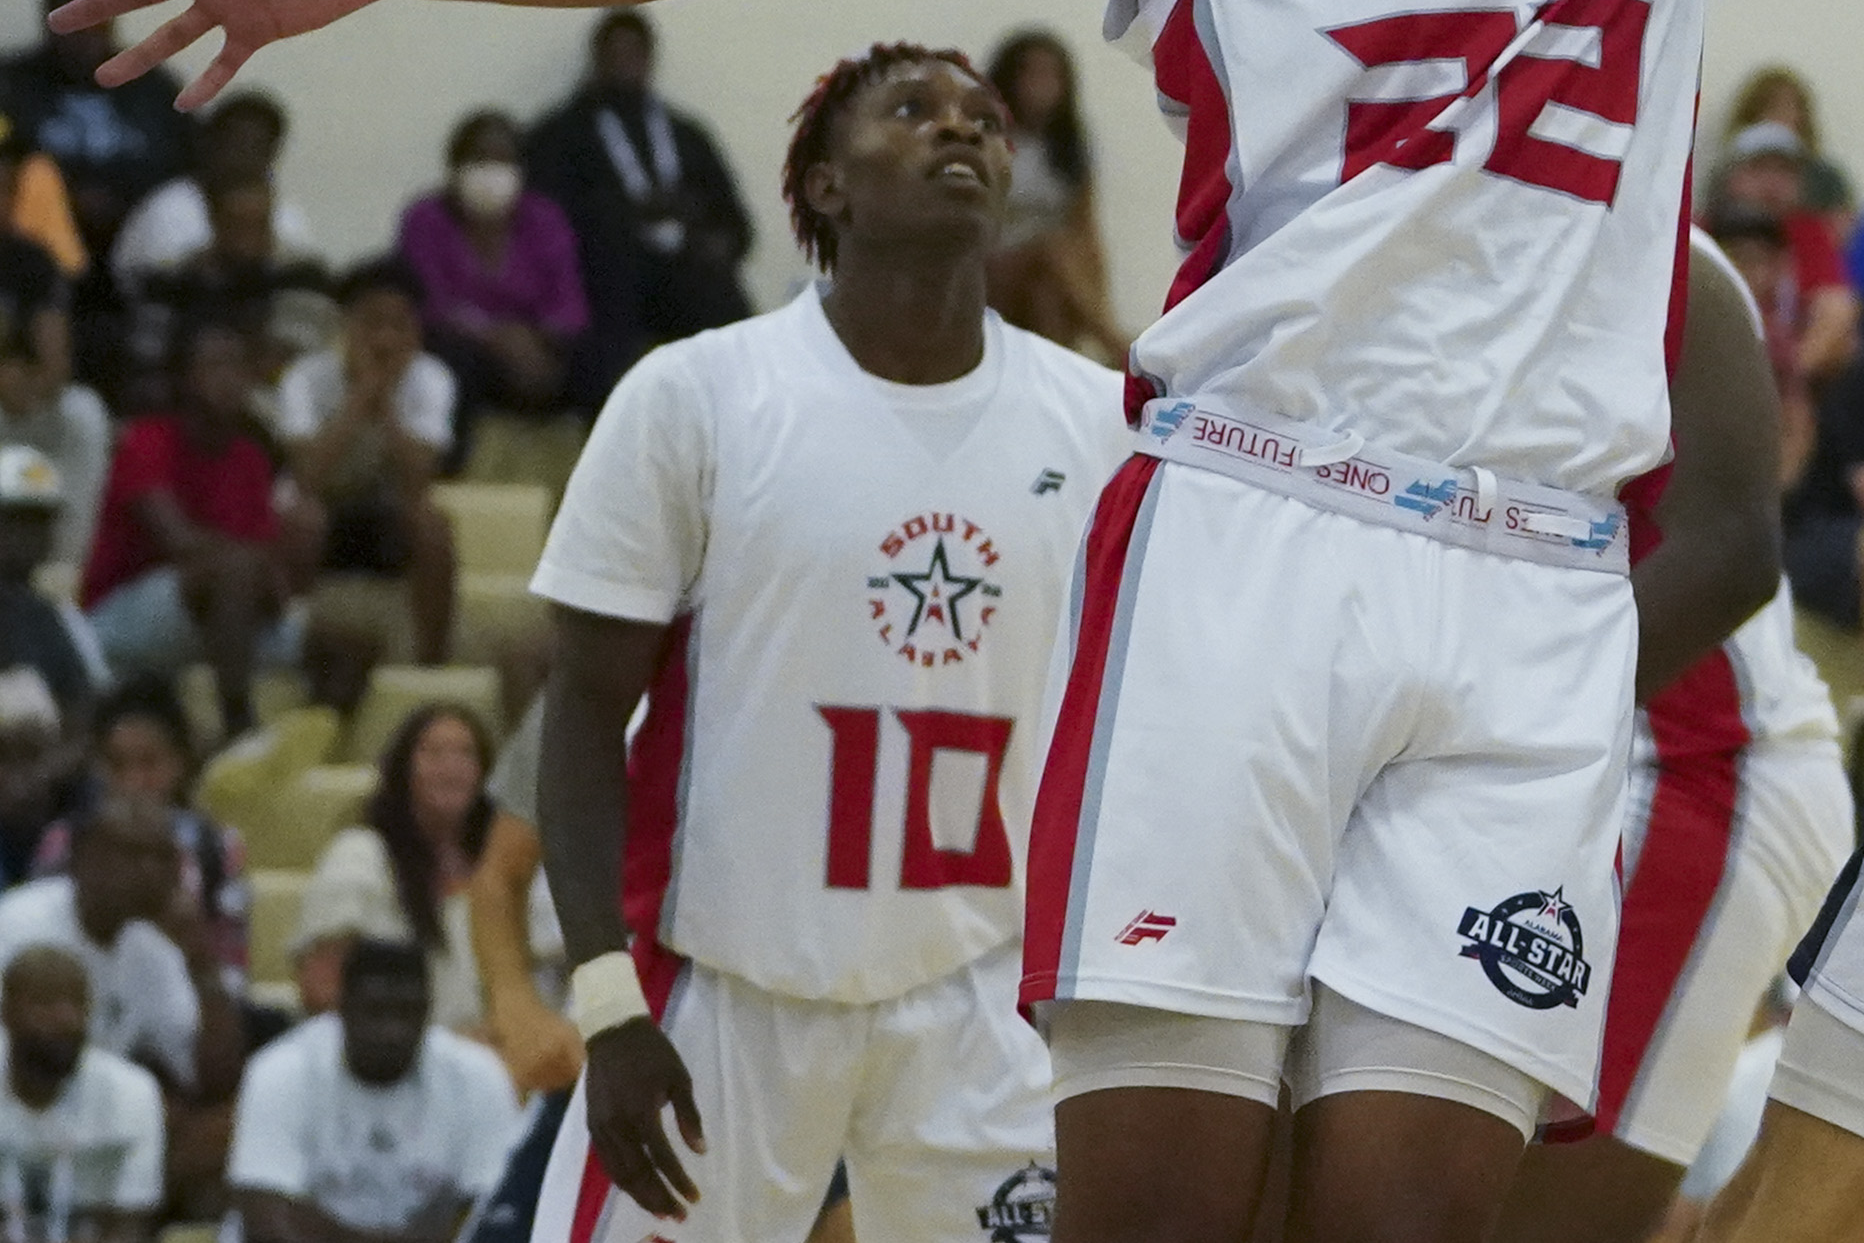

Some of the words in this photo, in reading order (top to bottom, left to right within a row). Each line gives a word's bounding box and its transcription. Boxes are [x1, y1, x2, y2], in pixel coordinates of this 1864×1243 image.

[1192, 415, 1298, 468] FUTURE
[1315, 461, 1390, 495] ONES
[812, 700, 1016, 890] 10
[1467, 913, 1586, 990] ALL-STAR
